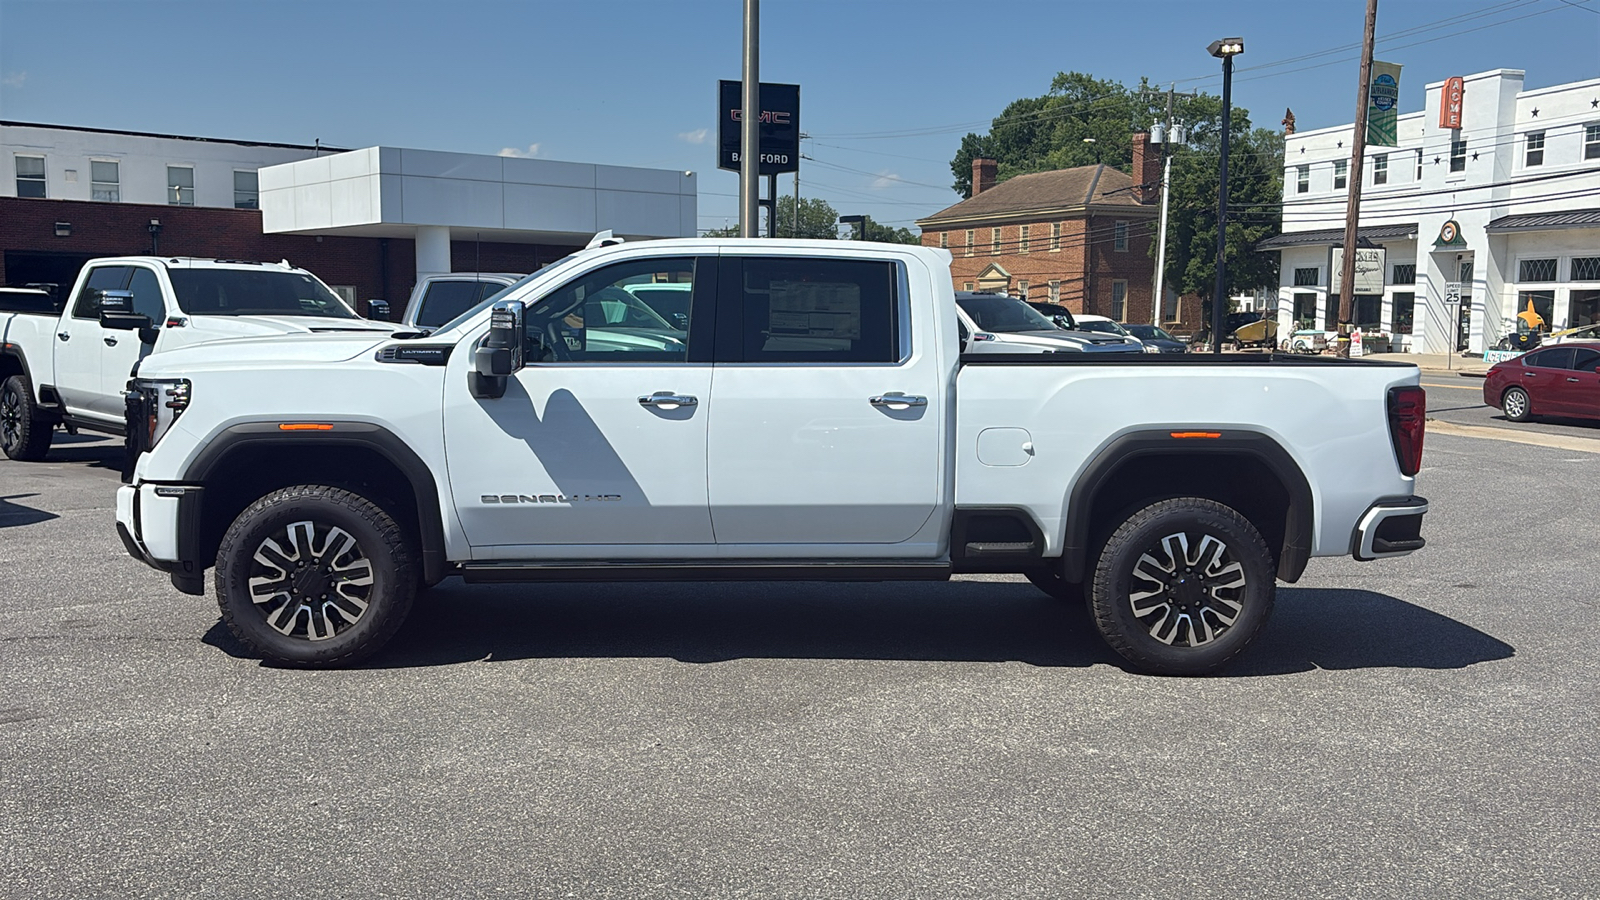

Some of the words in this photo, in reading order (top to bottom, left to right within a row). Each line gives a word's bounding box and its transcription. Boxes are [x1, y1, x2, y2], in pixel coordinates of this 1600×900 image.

[1450, 80, 1460, 125] ACME
[1446, 293, 1460, 302] 25
[481, 495, 578, 503] DENALI
